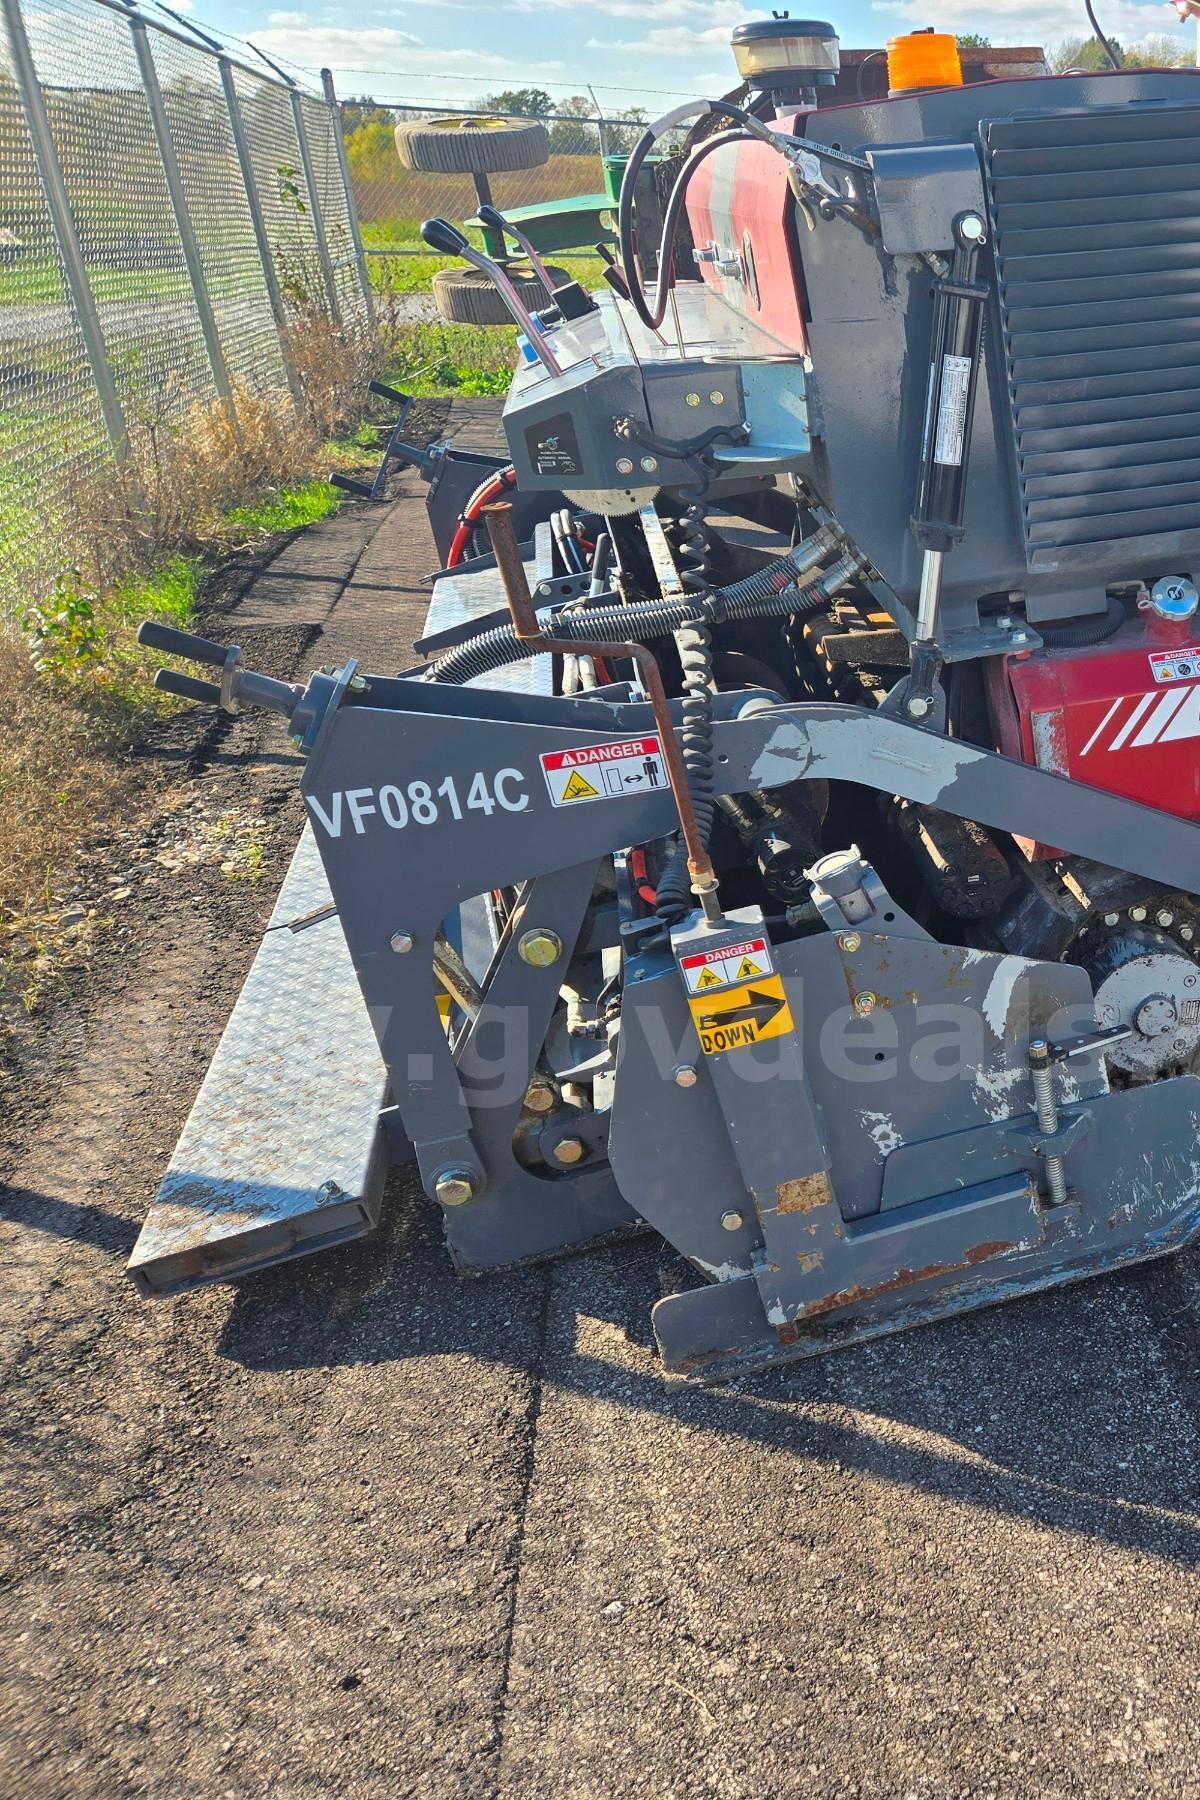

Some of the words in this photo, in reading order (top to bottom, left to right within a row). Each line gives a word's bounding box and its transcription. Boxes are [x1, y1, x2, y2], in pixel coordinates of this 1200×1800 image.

[1170, 651, 1197, 660] DANGER
[575, 742, 645, 764] DANGER
[306, 767, 529, 838] VF0814C
[705, 943, 754, 963] DANGER
[701, 1024, 755, 1053] DOWN
